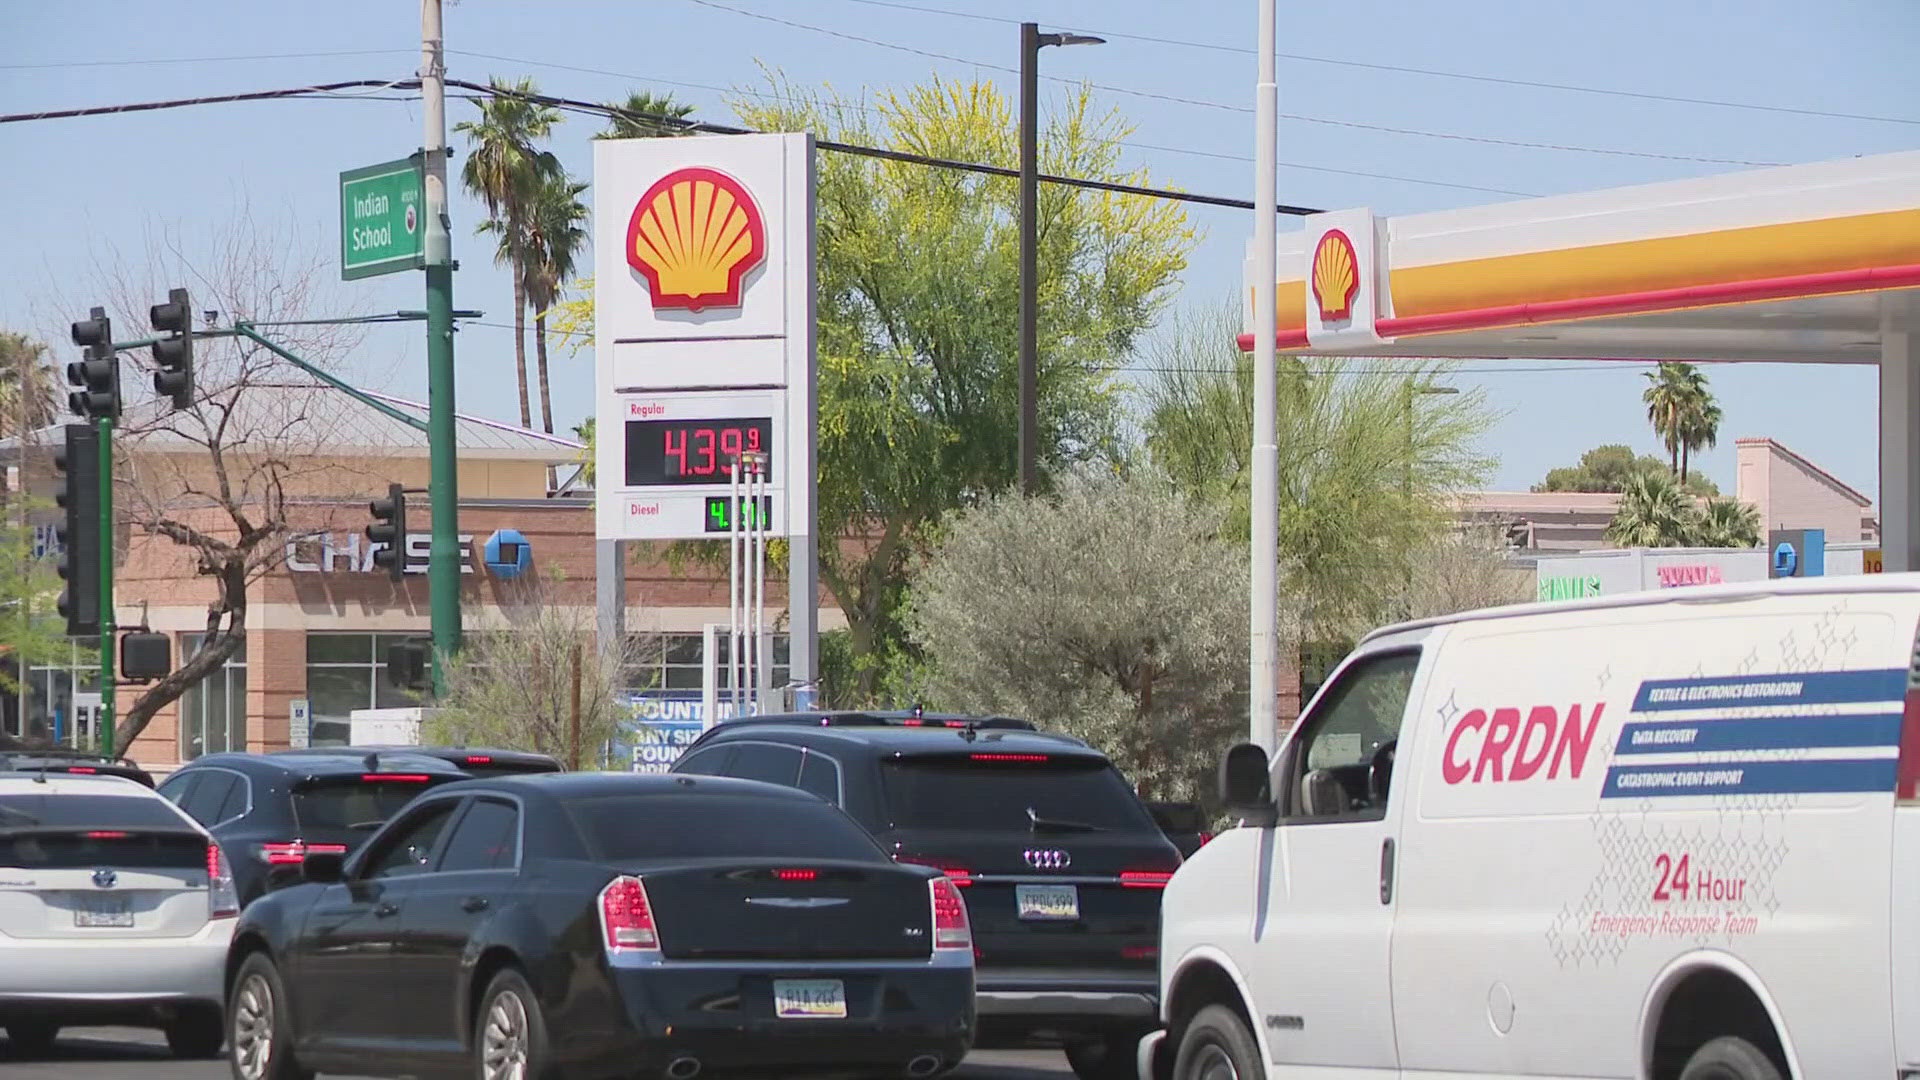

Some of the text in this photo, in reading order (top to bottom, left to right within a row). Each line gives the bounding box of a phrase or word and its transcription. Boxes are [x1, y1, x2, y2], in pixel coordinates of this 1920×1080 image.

[353, 191, 390, 219] Indian
[352, 221, 392, 251] School
[630, 402, 665, 417] Regular
[631, 503, 659, 516] Diesel
[1688, 683, 1744, 701] ELECTRONICS
[1743, 681, 1804, 698] RESTORATION
[1442, 702, 1607, 785] CRDN
[1632, 728, 1699, 745] DATA RECOVERY
[632, 745, 688, 762] FOUN
[1617, 769, 1744, 788] CATASTROPHIC EVENT SUPPORT
[1653, 852, 1746, 901] 24 Hour
[1591, 909, 1759, 939] Emergency Response Team
